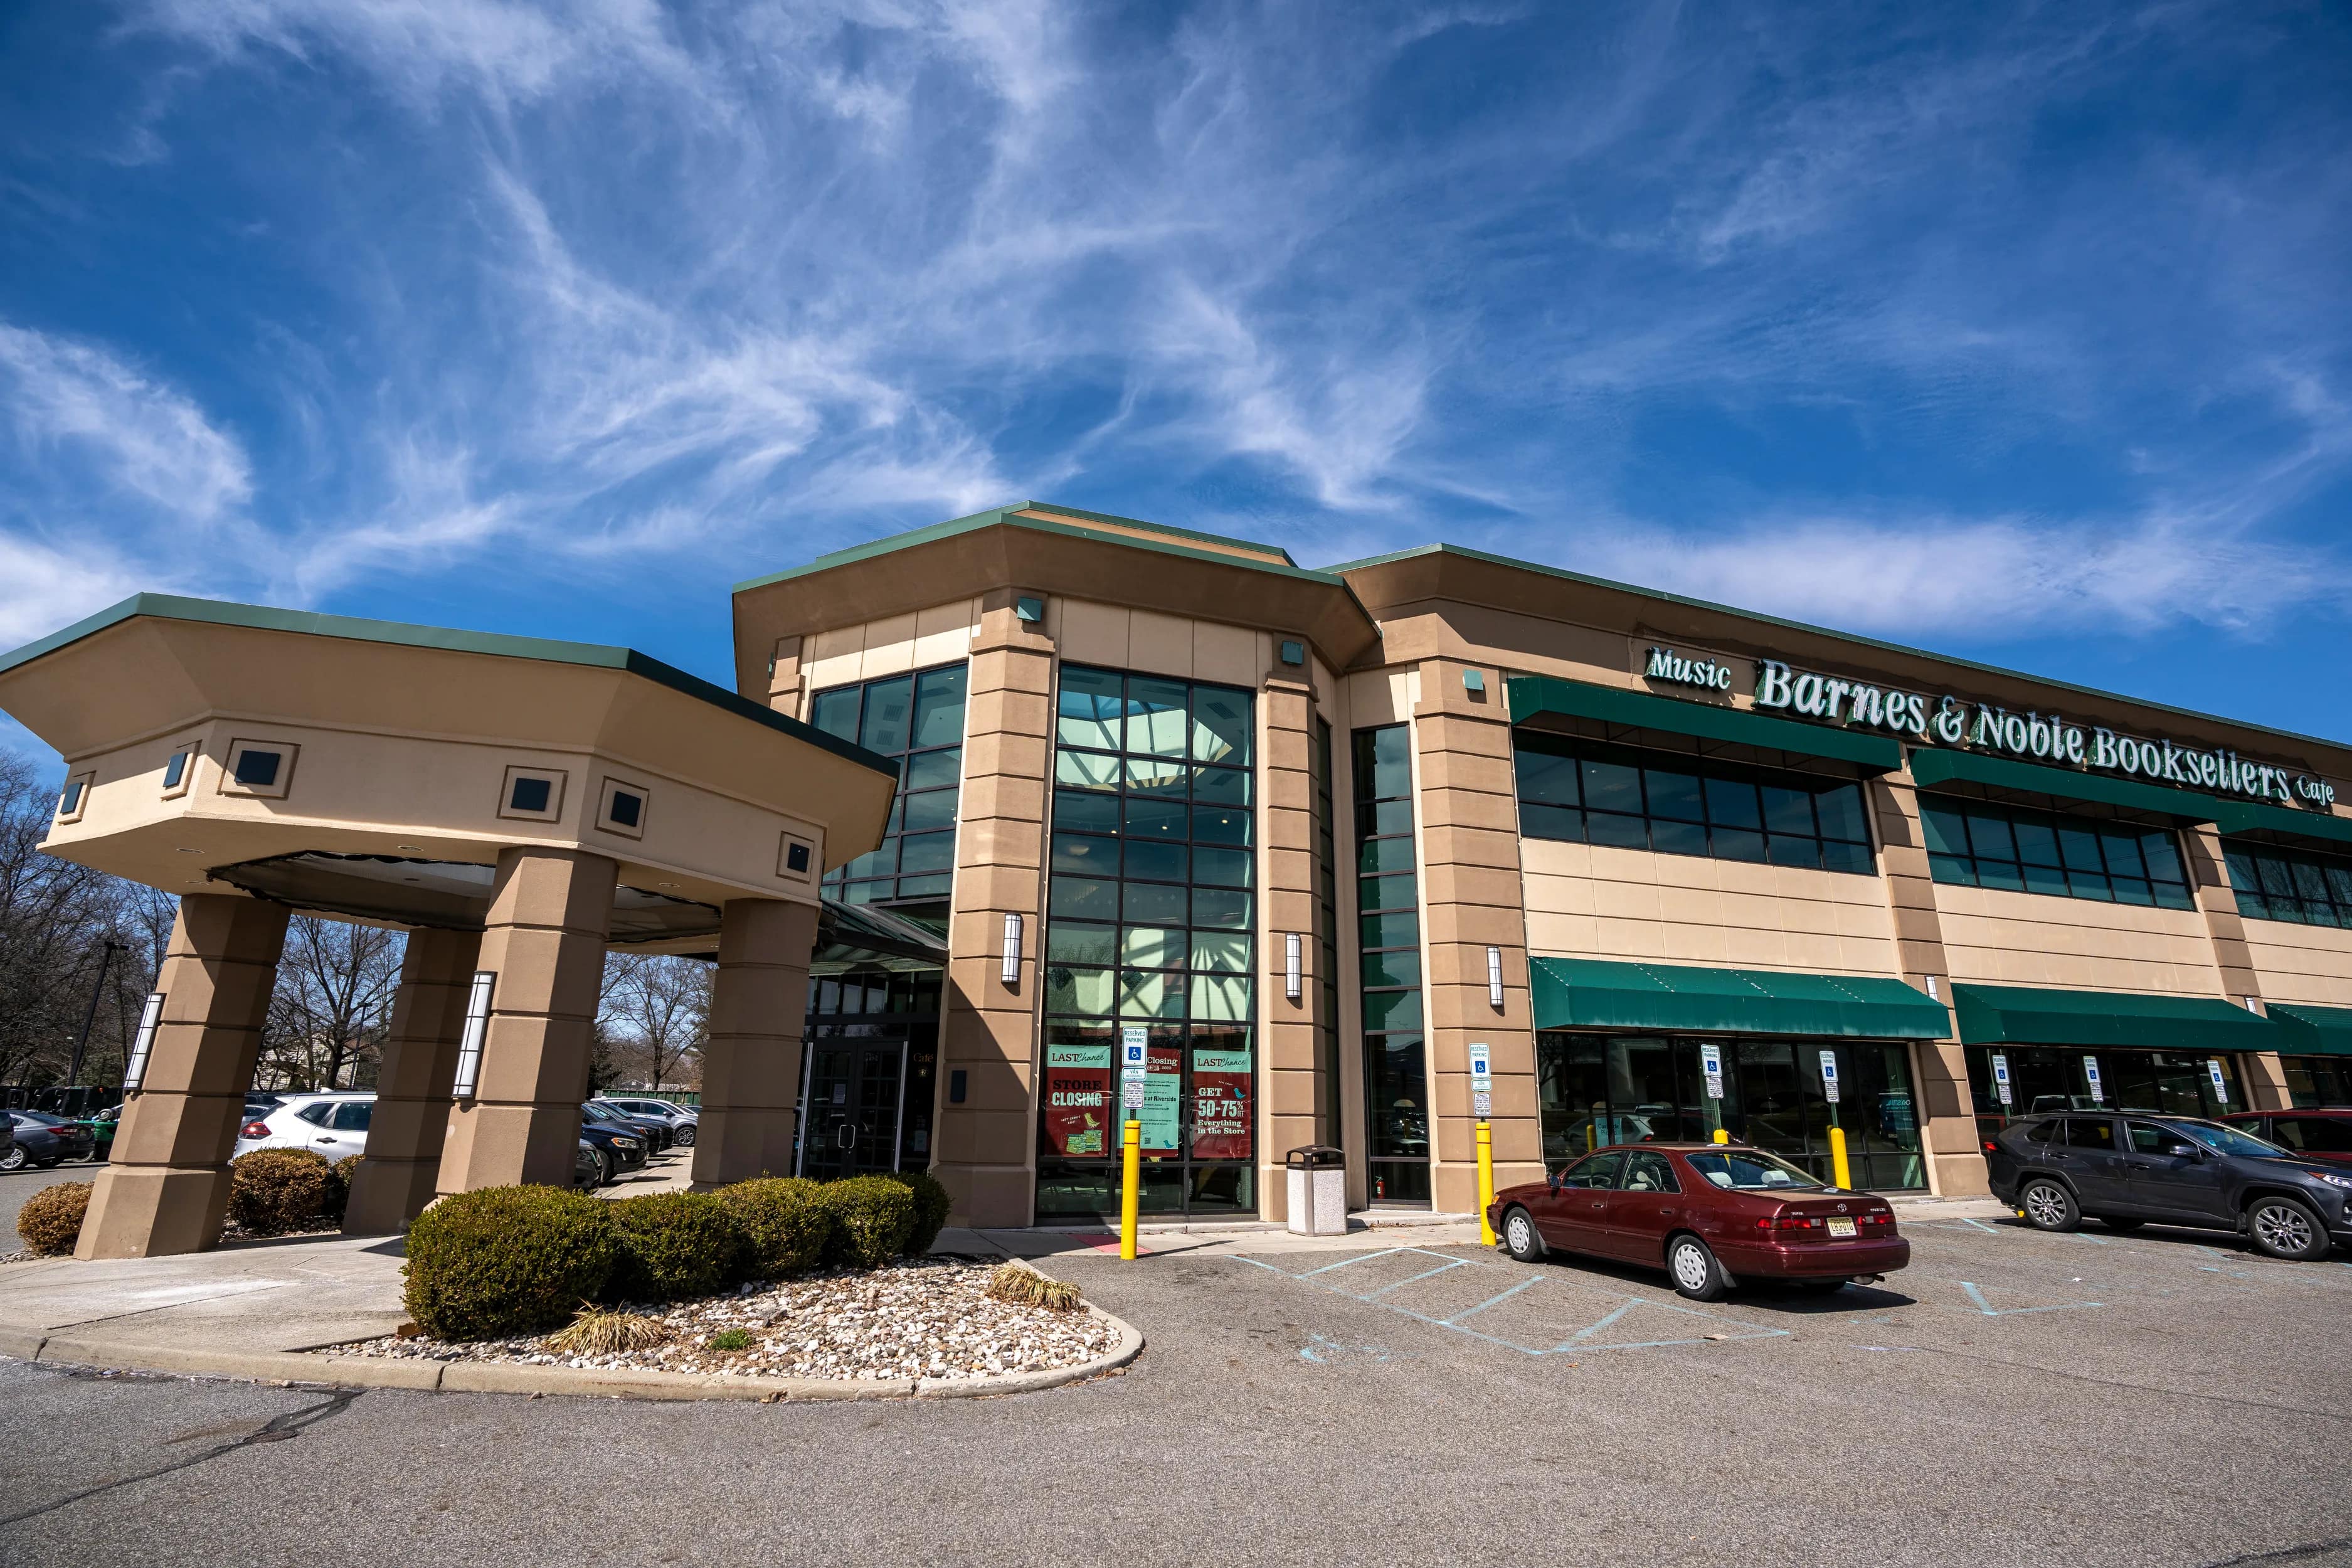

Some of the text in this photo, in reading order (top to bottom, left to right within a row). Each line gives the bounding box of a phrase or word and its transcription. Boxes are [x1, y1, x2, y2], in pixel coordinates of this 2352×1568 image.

[1650, 647, 1731, 690] Music
[1759, 659, 1926, 734] Barnes
[1931, 695, 1965, 743] &
[1976, 703, 2084, 765] Noble
[2092, 726, 2291, 802] Booksellers
[913, 1053, 934, 1062] Café
[1052, 1052, 1104, 1062] LAST Chance
[1147, 1057, 1178, 1066] Closing
[1197, 1057, 1246, 1067] LAST Chance
[1053, 1079, 1102, 1090] STORE
[1199, 1088, 1222, 1096] GET
[1052, 1092, 1102, 1106] CLOSING
[1198, 1120, 1242, 1128] Everything
